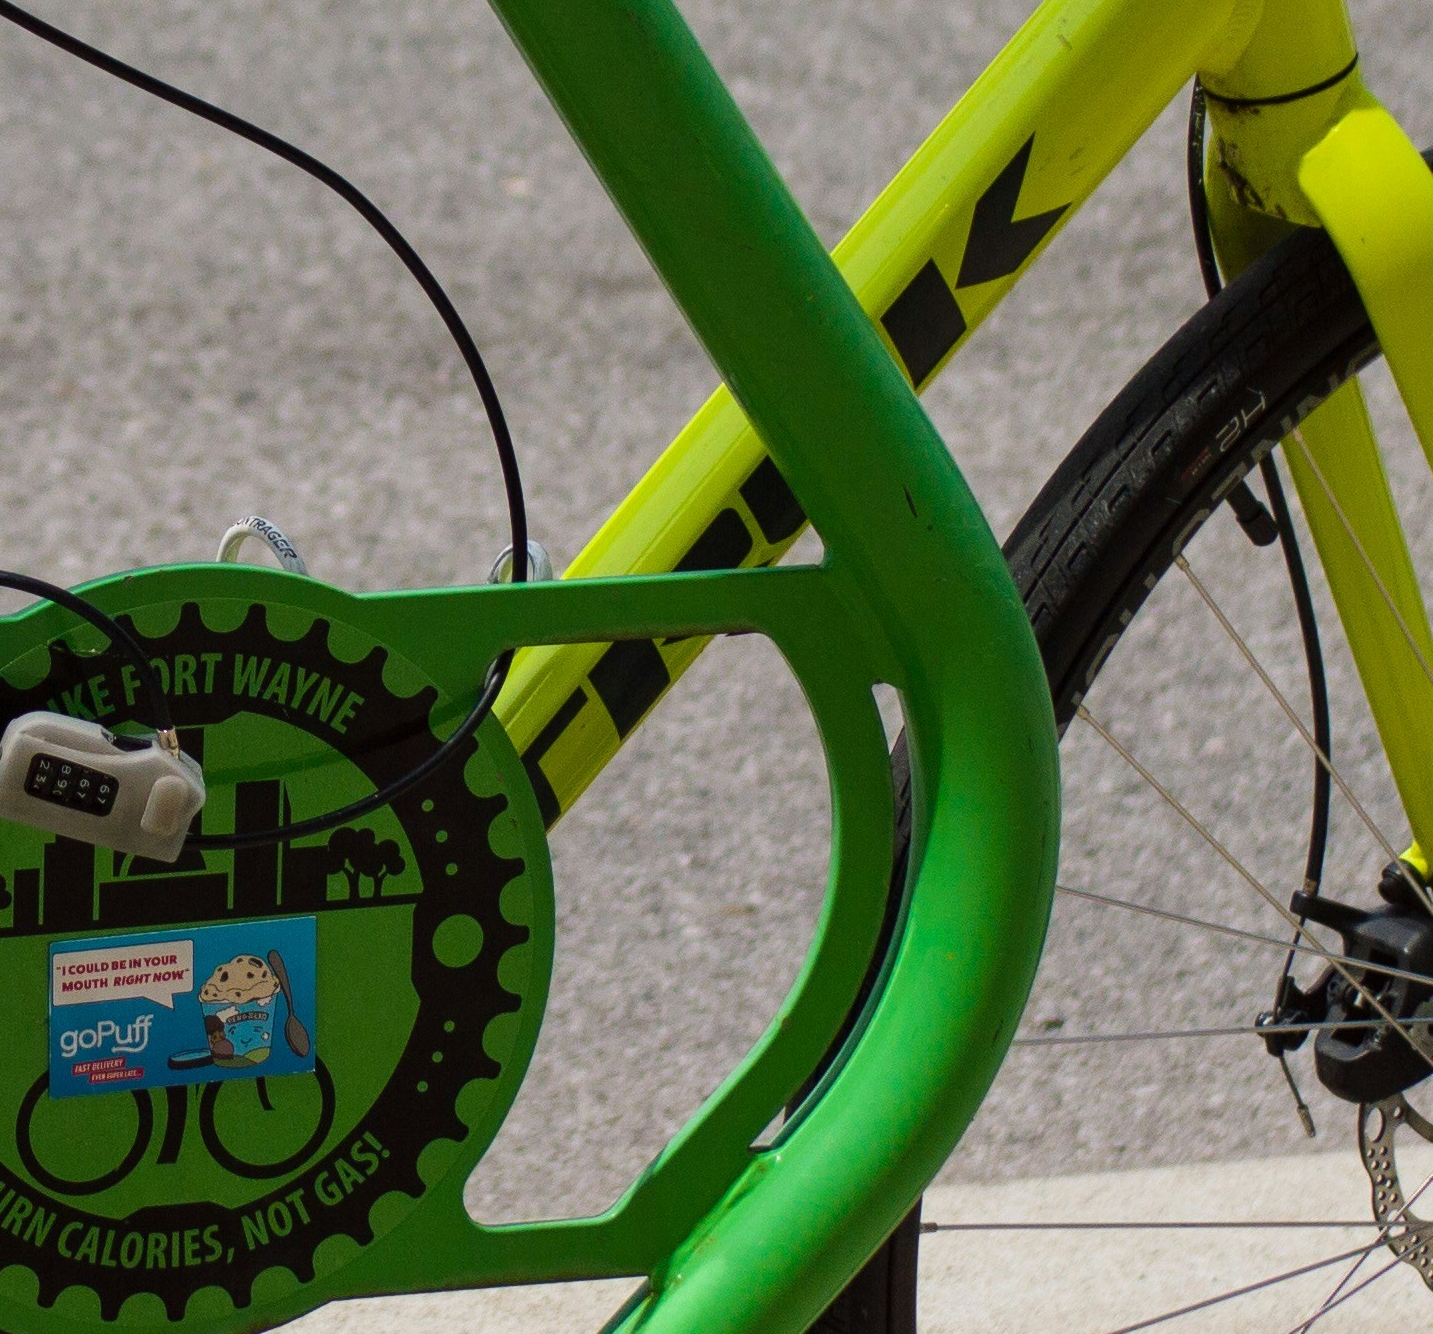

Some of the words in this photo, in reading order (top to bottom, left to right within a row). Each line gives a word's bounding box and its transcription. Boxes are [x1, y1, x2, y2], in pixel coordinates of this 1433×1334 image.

[236, 516, 298, 559] TRAGER
[232, 653, 365, 735] WAYNE
[61, 978, 109, 993] MOUTH
[113, 973, 152, 987] RIGHT
[68, 961, 109, 975] COULD
[110, 959, 127, 971] BE
[128, 957, 142, 969] IN
[143, 954, 177, 967] YOUR
[59, 1013, 155, 1058] goPuff
[57, 1222, 236, 1269] CALORIES,
[240, 1188, 313, 1252] NOT
[314, 1131, 391, 1206] GAS!
